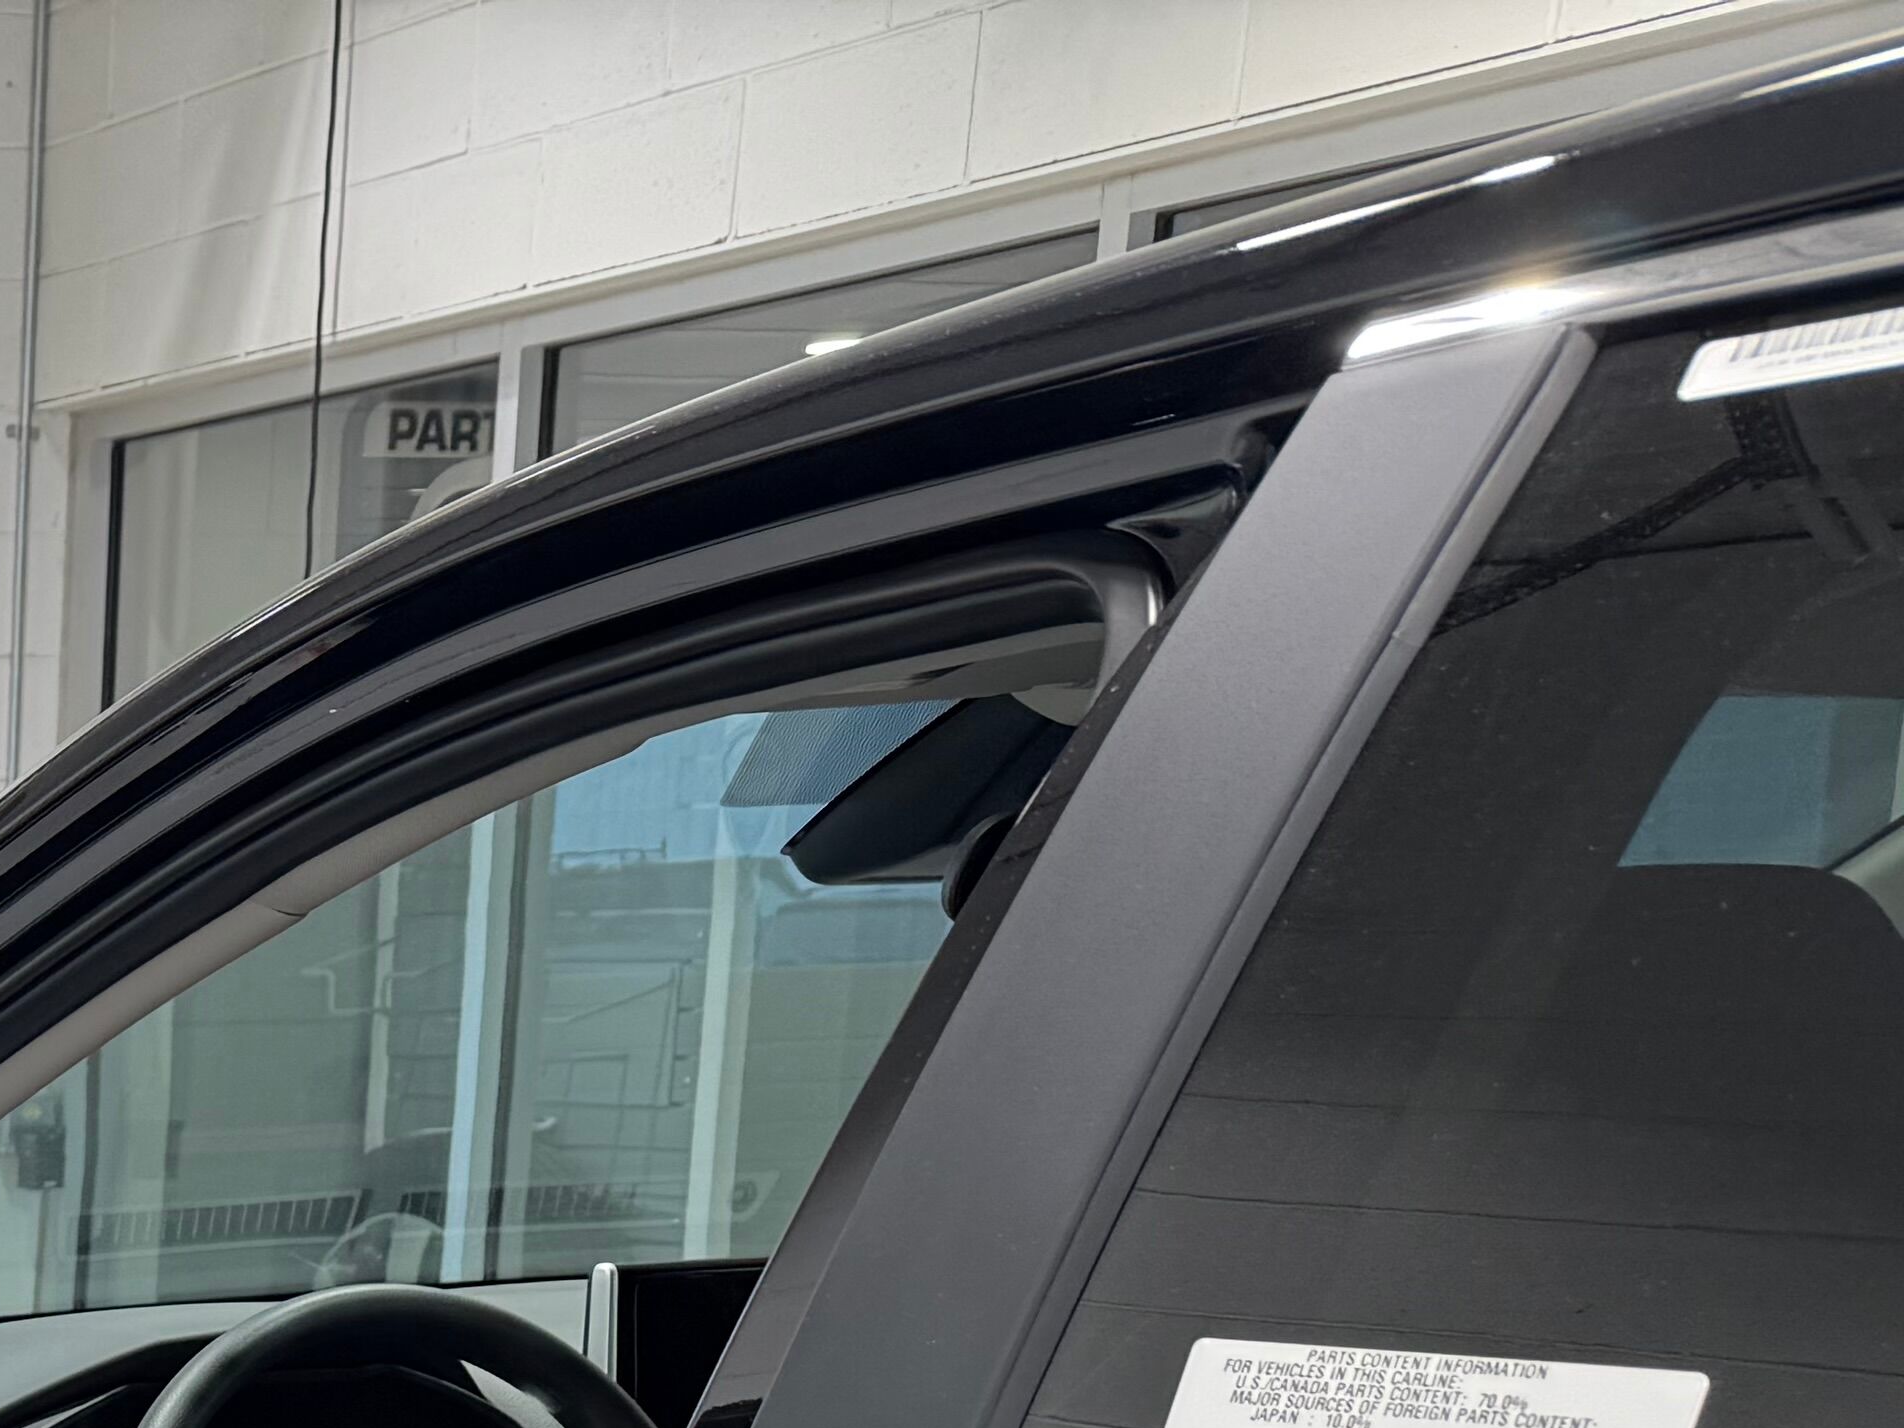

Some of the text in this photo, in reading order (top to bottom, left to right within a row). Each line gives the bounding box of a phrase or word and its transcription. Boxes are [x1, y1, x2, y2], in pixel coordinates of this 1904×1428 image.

[1224, 1358, 1464, 1389] FOR VEHICLES IN THIS CARLINE:
[1307, 1349, 1550, 1379] PARTS CONTENT INFORMATION
[1230, 1390, 1281, 1407] MAJOR
[1286, 1394, 1353, 1414] SOURCES
[1359, 1400, 1381, 1415] OF
[1383, 1402, 1451, 1421] FOREIGN
[1455, 1408, 1509, 1426] PARTS
[1335, 1382, 1384, 1399] PARTS
[1390, 1386, 1467, 1406] CONTENT:
[1250, 1408, 1300, 1424] JAPAN
